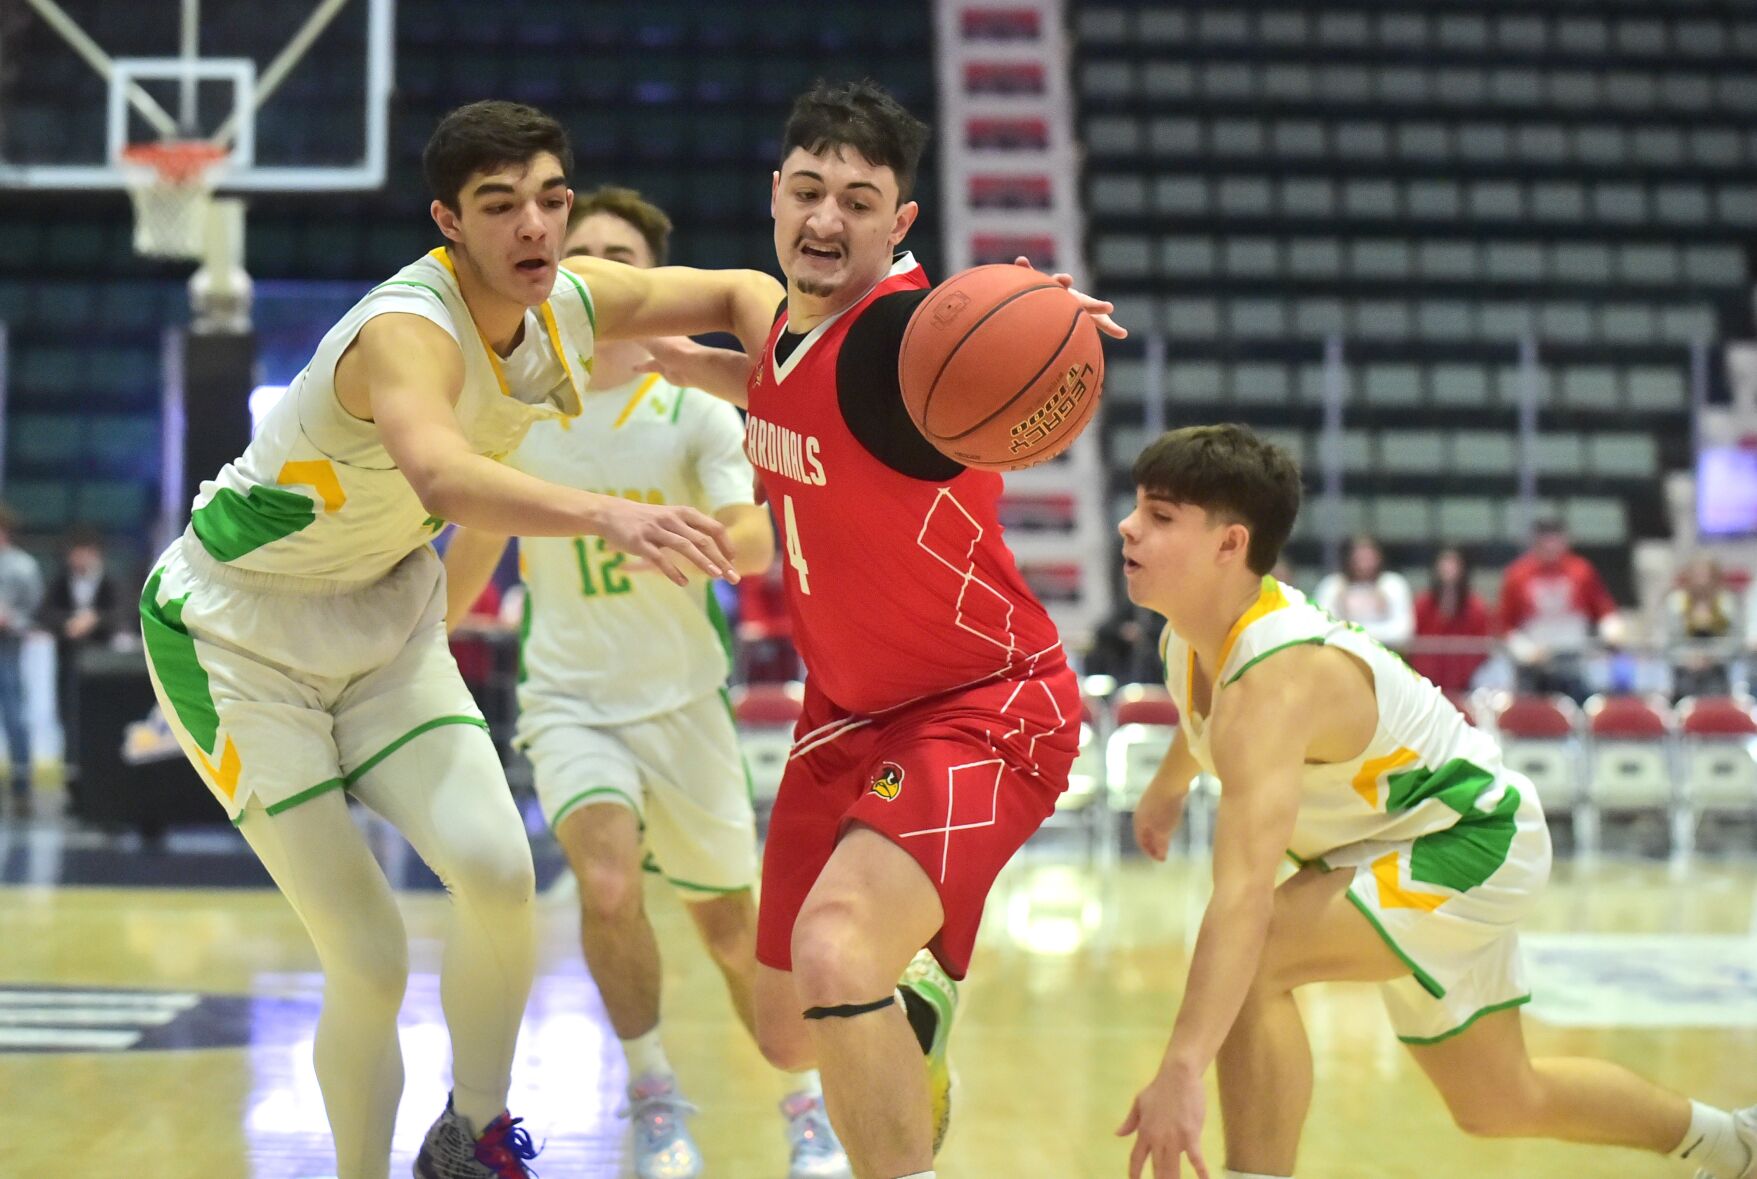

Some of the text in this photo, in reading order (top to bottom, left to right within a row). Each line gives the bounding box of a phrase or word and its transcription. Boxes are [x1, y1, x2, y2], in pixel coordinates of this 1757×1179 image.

[746, 412, 826, 486] ARDINALS
[1009, 362, 1094, 454] LEGACY
[574, 537, 631, 596] 12
[784, 494, 810, 595] 4
